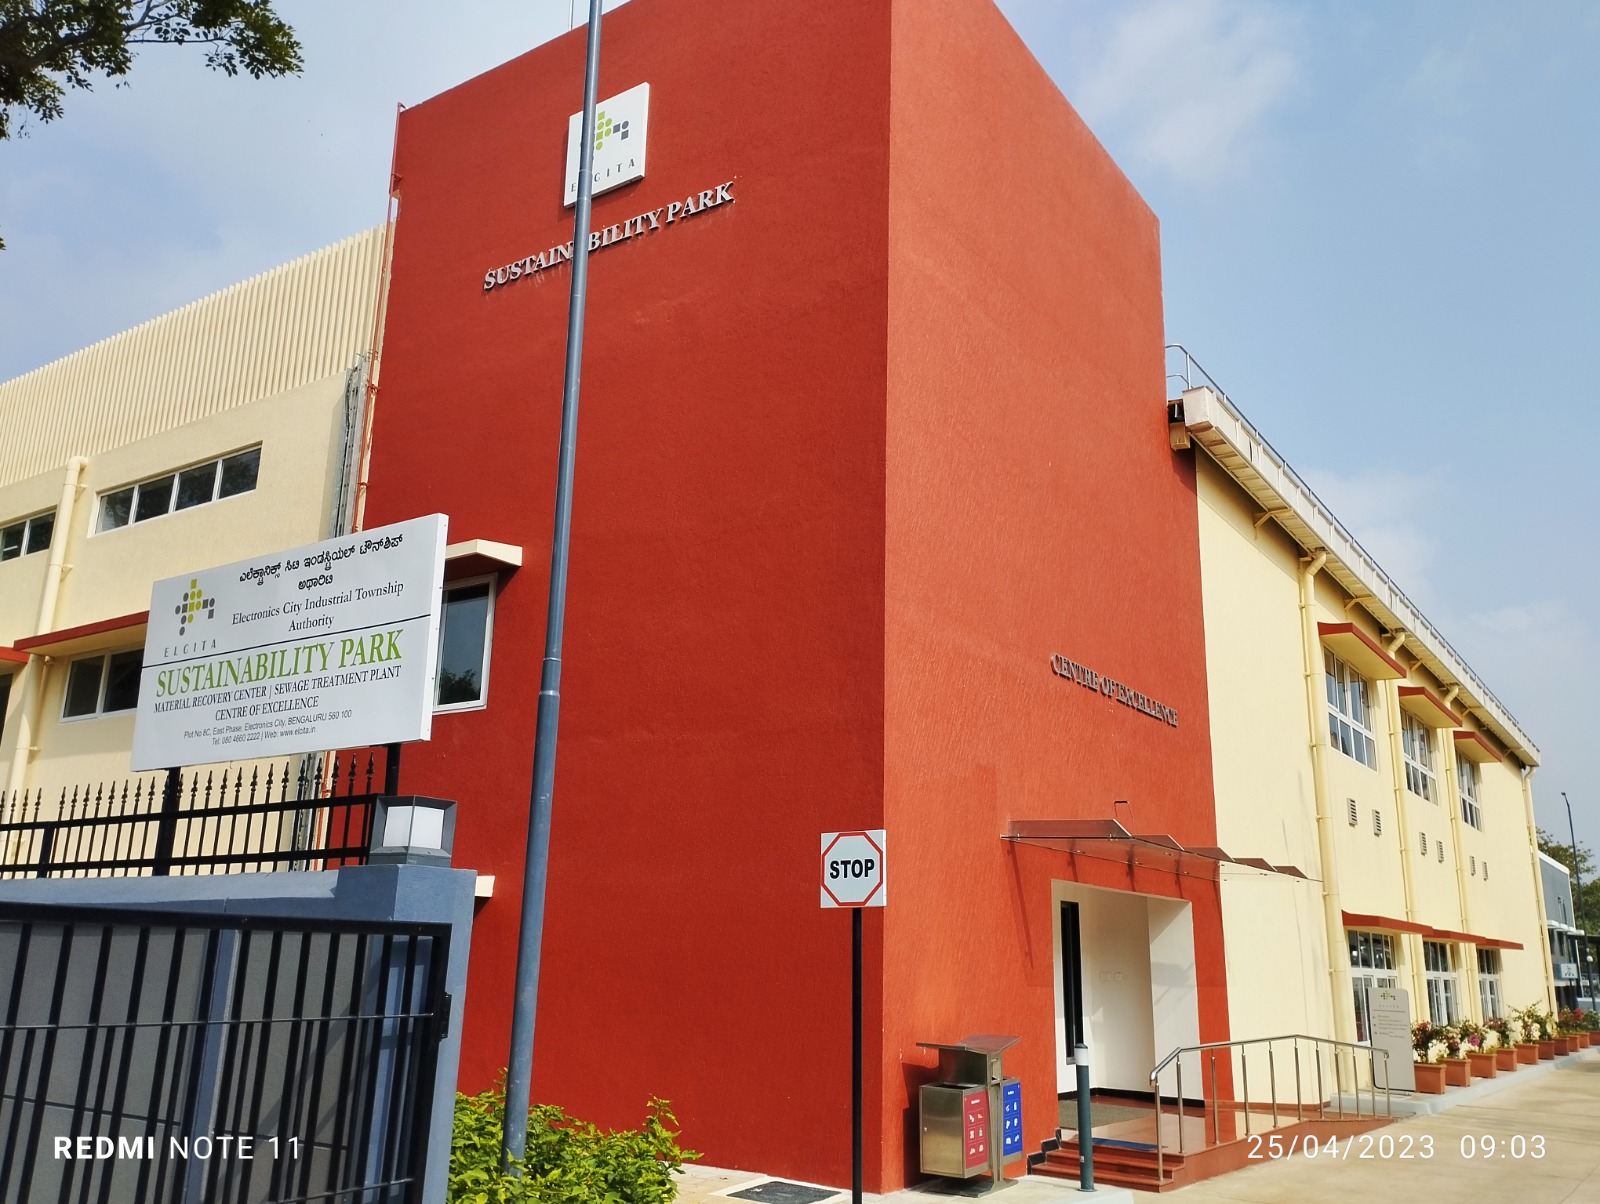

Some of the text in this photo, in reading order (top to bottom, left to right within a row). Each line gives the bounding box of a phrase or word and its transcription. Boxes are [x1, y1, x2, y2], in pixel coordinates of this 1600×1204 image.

[570, 158, 635, 193] ECITA
[483, 181, 736, 290] SUSTAINBILITY PARK
[285, 559, 300, 572] ಸಿಟಿ
[232, 580, 404, 625] Electronics City Industrial Township
[288, 614, 335, 632] Authority
[163, 639, 216, 658] ELCITA
[156, 629, 404, 698] SUSTAINABILITY PARK
[153, 697, 191, 714] MATERIAL
[192, 690, 234, 707] RECOVERY
[233, 685, 267, 701] CENTER
[274, 678, 310, 696] SEWAGE
[311, 670, 368, 690] TREATMENT
[370, 665, 402, 681] PLANT
[1050, 652, 1179, 729] CENTRE OF EXCELLENCE
[215, 695, 319, 721] CENTRE OF EXCELLENCE
[183, 730, 194, 738] Plot
[194, 729, 202, 737] No
[212, 726, 225, 735] East
[244, 720, 273, 731] Electronics
[287, 712, 327, 726] BENGALURU
[328, 710, 340, 720] 560
[341, 709, 352, 718] 100
[246, 731, 260, 741] 2222
[829, 858, 875, 879] STOP
